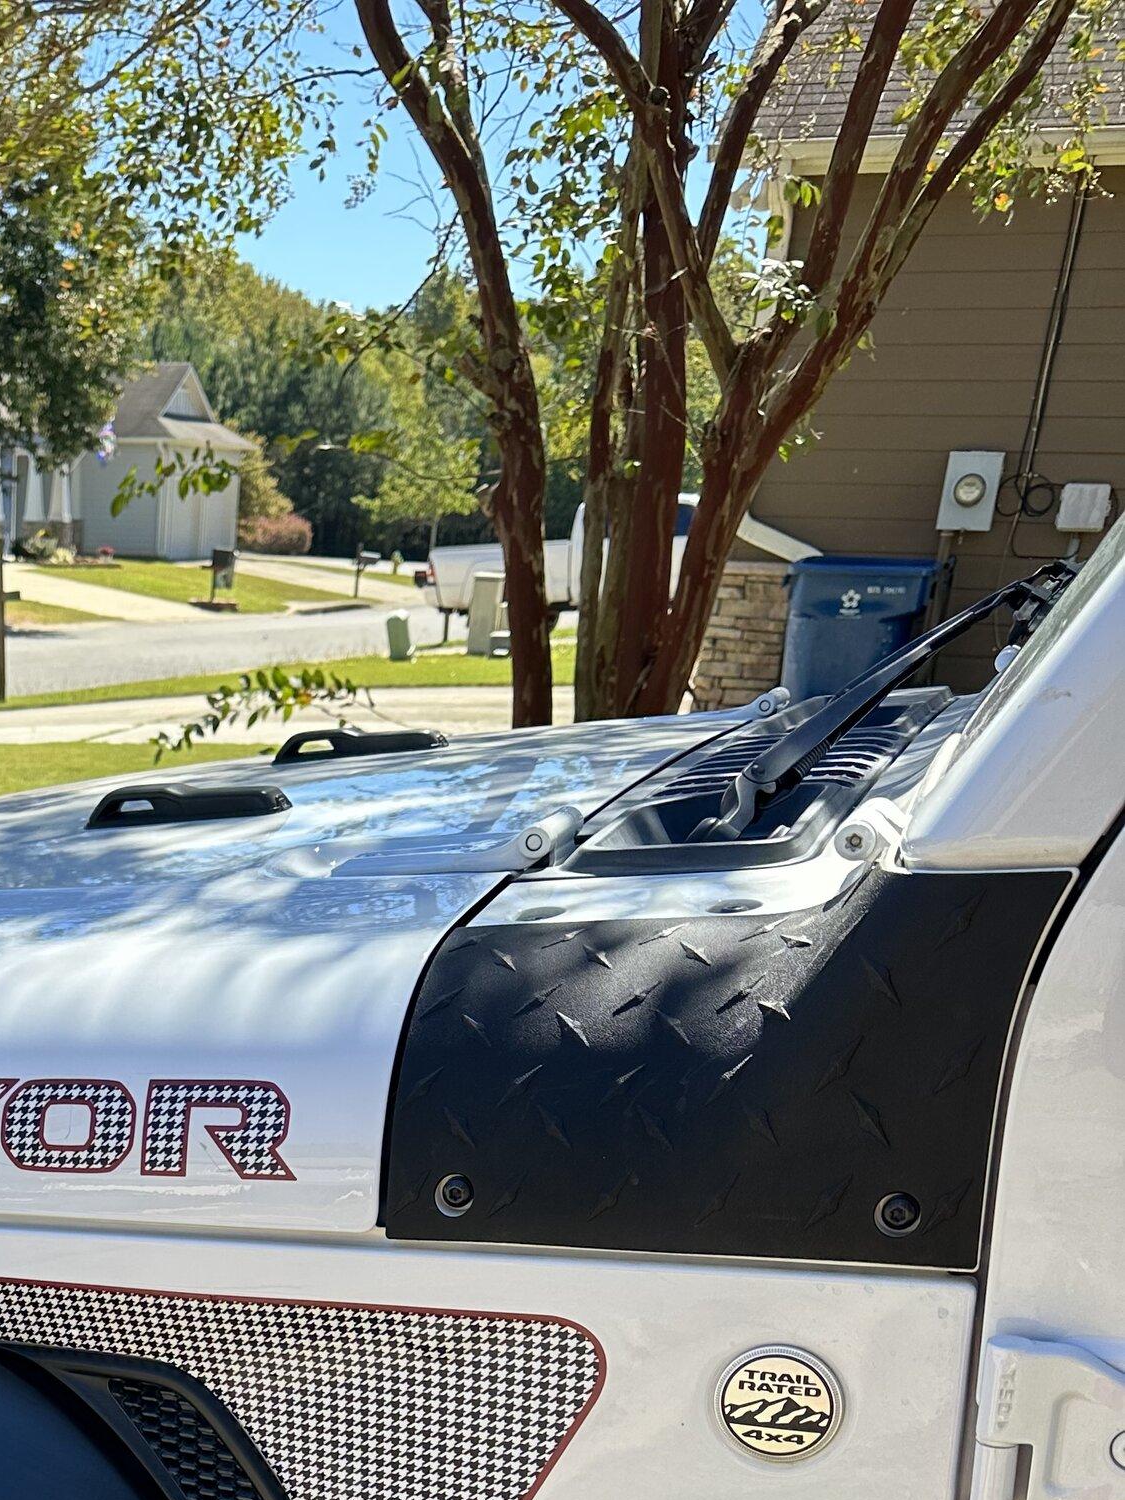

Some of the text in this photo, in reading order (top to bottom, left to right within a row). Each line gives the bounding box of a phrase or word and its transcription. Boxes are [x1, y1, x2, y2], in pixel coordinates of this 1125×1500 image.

[743, 1369, 817, 1386] TRAIL
[738, 1380, 822, 1398] RATED
[742, 1429, 806, 1445] 4x4
